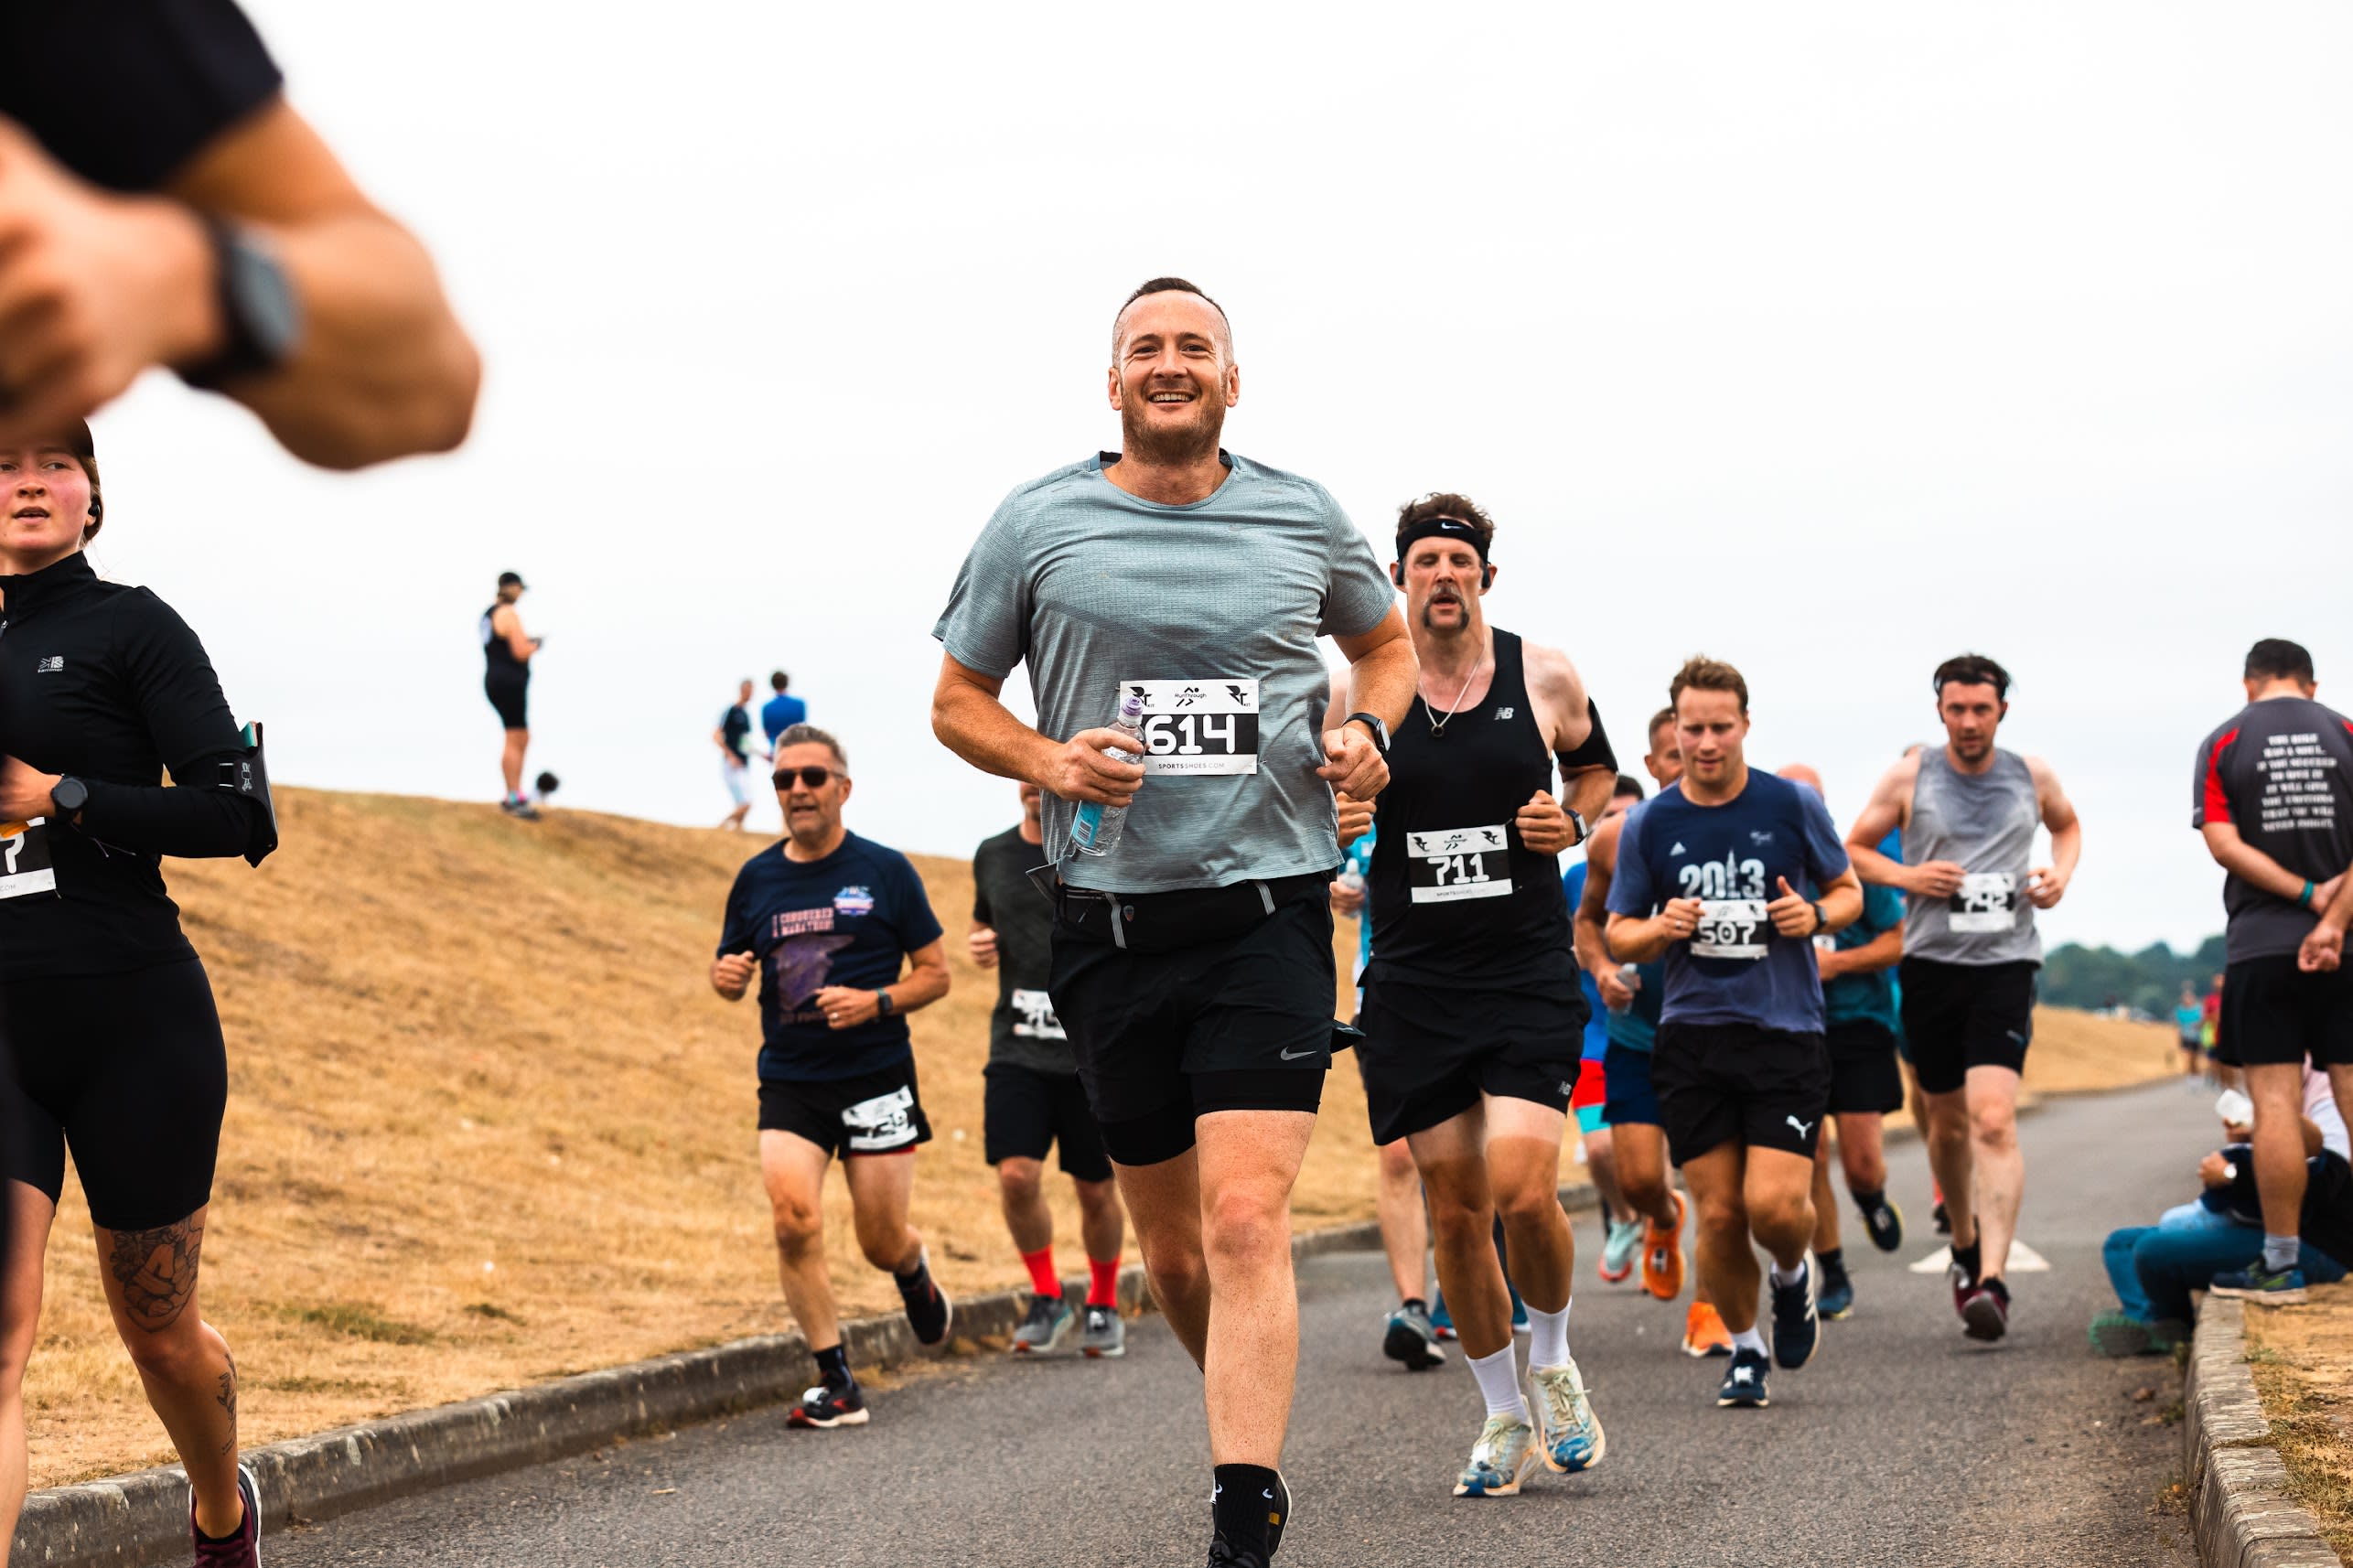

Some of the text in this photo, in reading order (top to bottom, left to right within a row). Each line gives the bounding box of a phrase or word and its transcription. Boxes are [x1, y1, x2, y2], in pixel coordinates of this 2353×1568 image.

[1144, 714, 1236, 755] 614
[1427, 853, 1490, 886] 711
[1697, 920, 1757, 945] 507
